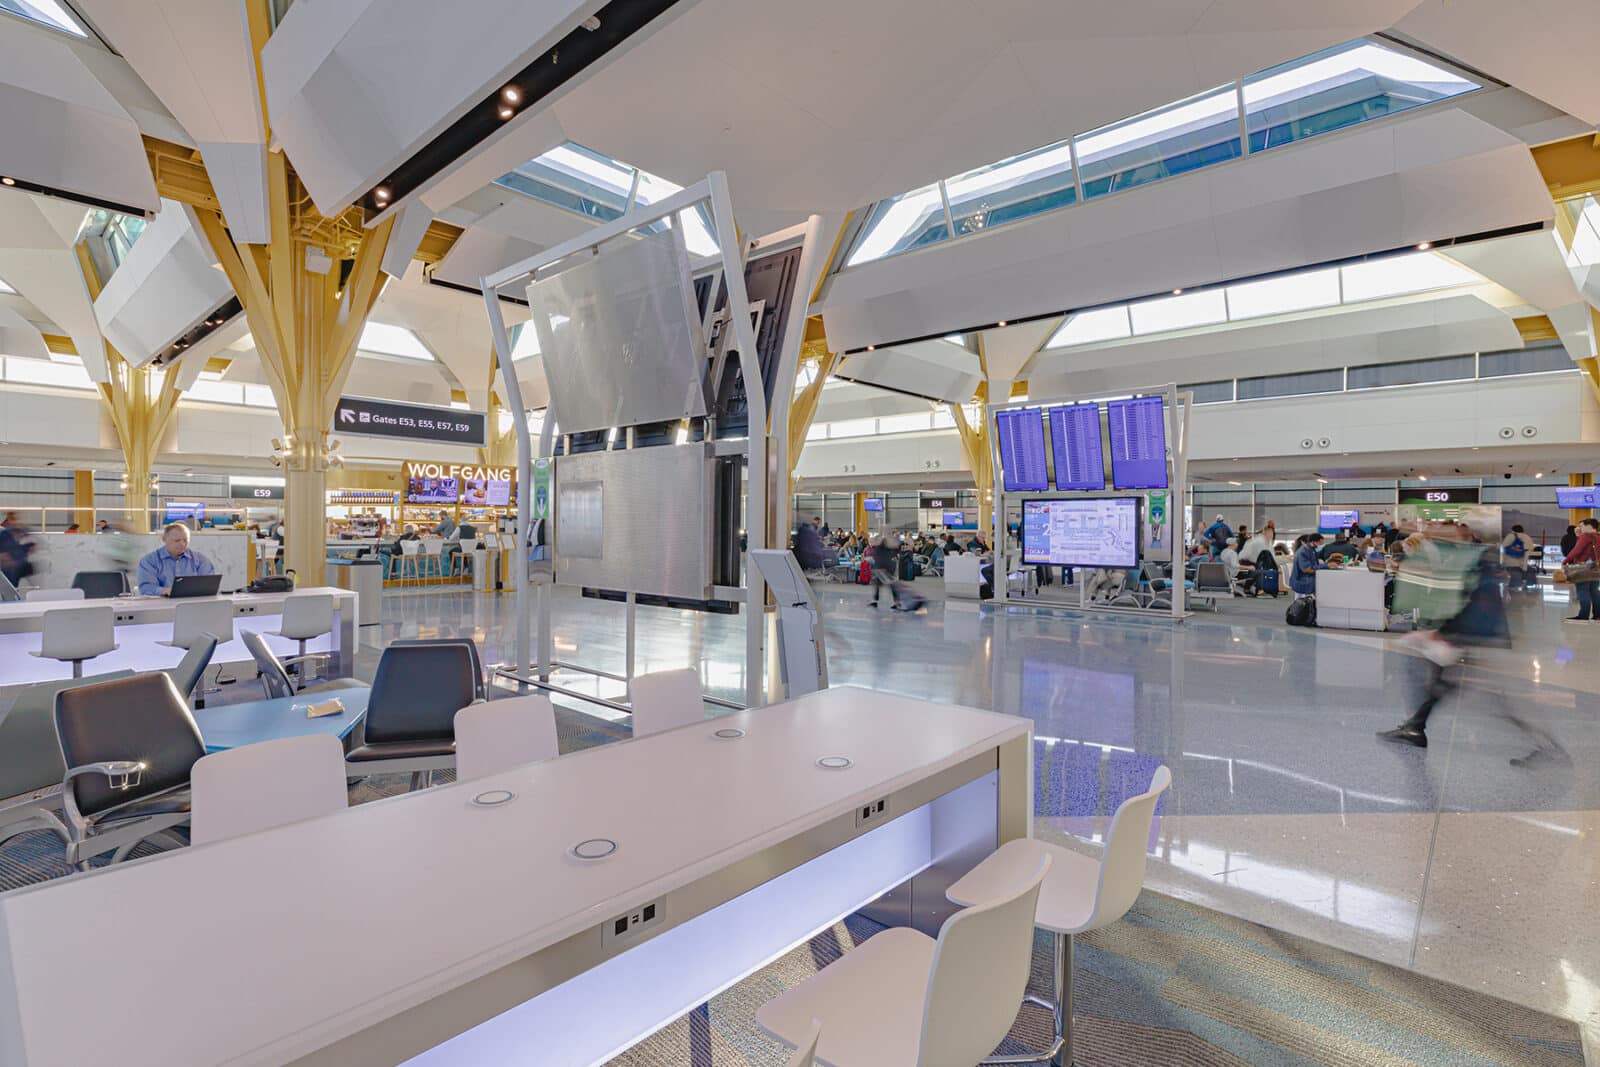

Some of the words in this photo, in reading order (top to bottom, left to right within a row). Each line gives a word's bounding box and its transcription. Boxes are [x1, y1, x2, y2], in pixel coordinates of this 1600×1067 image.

[372, 414, 397, 425] Gates
[399, 417, 416, 428] E53,
[418, 420, 435, 430] E55,
[437, 421, 454, 431] E57,
[455, 423, 470, 432] E59
[407, 463, 511, 482] WOLFGANG
[253, 488, 272, 497] E59
[1426, 492, 1449, 502] E50
[931, 500, 943, 508] E54
